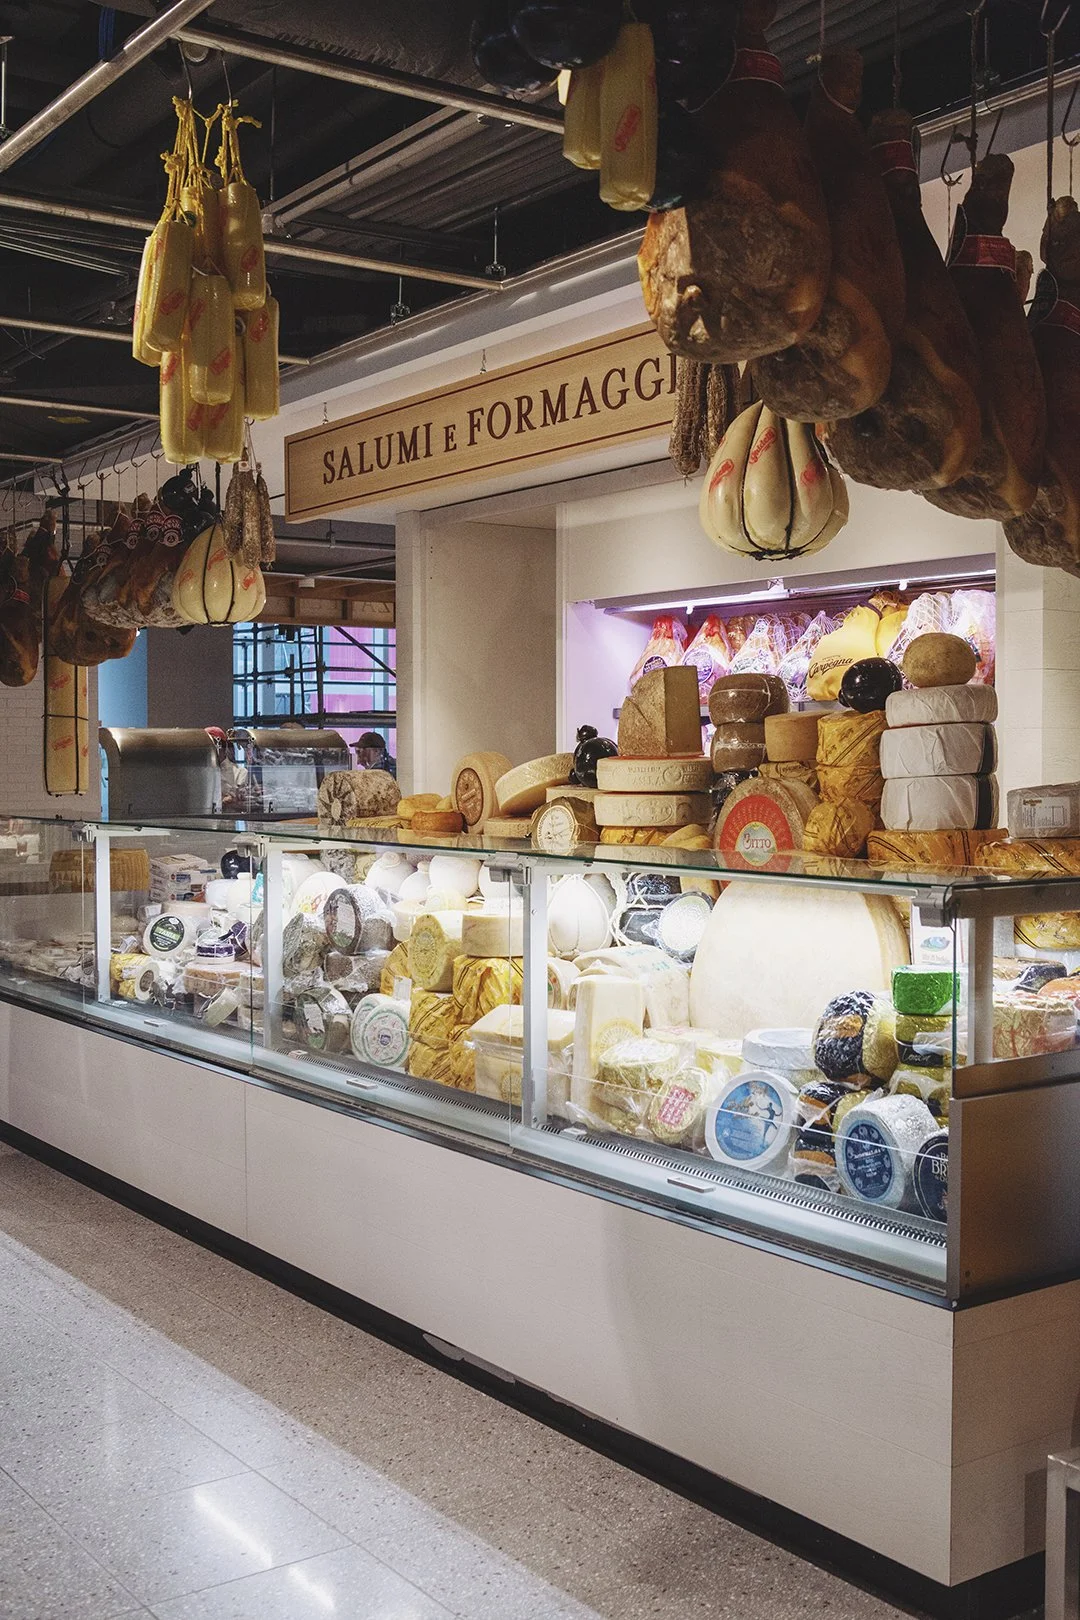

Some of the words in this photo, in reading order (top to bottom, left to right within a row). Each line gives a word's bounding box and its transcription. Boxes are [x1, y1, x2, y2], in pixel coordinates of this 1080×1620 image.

[324, 422, 433, 485] SALUMI
[444, 425, 456, 453] E
[467, 353, 677, 447] FORMAGGI
[808, 658, 854, 678] Carpegna
